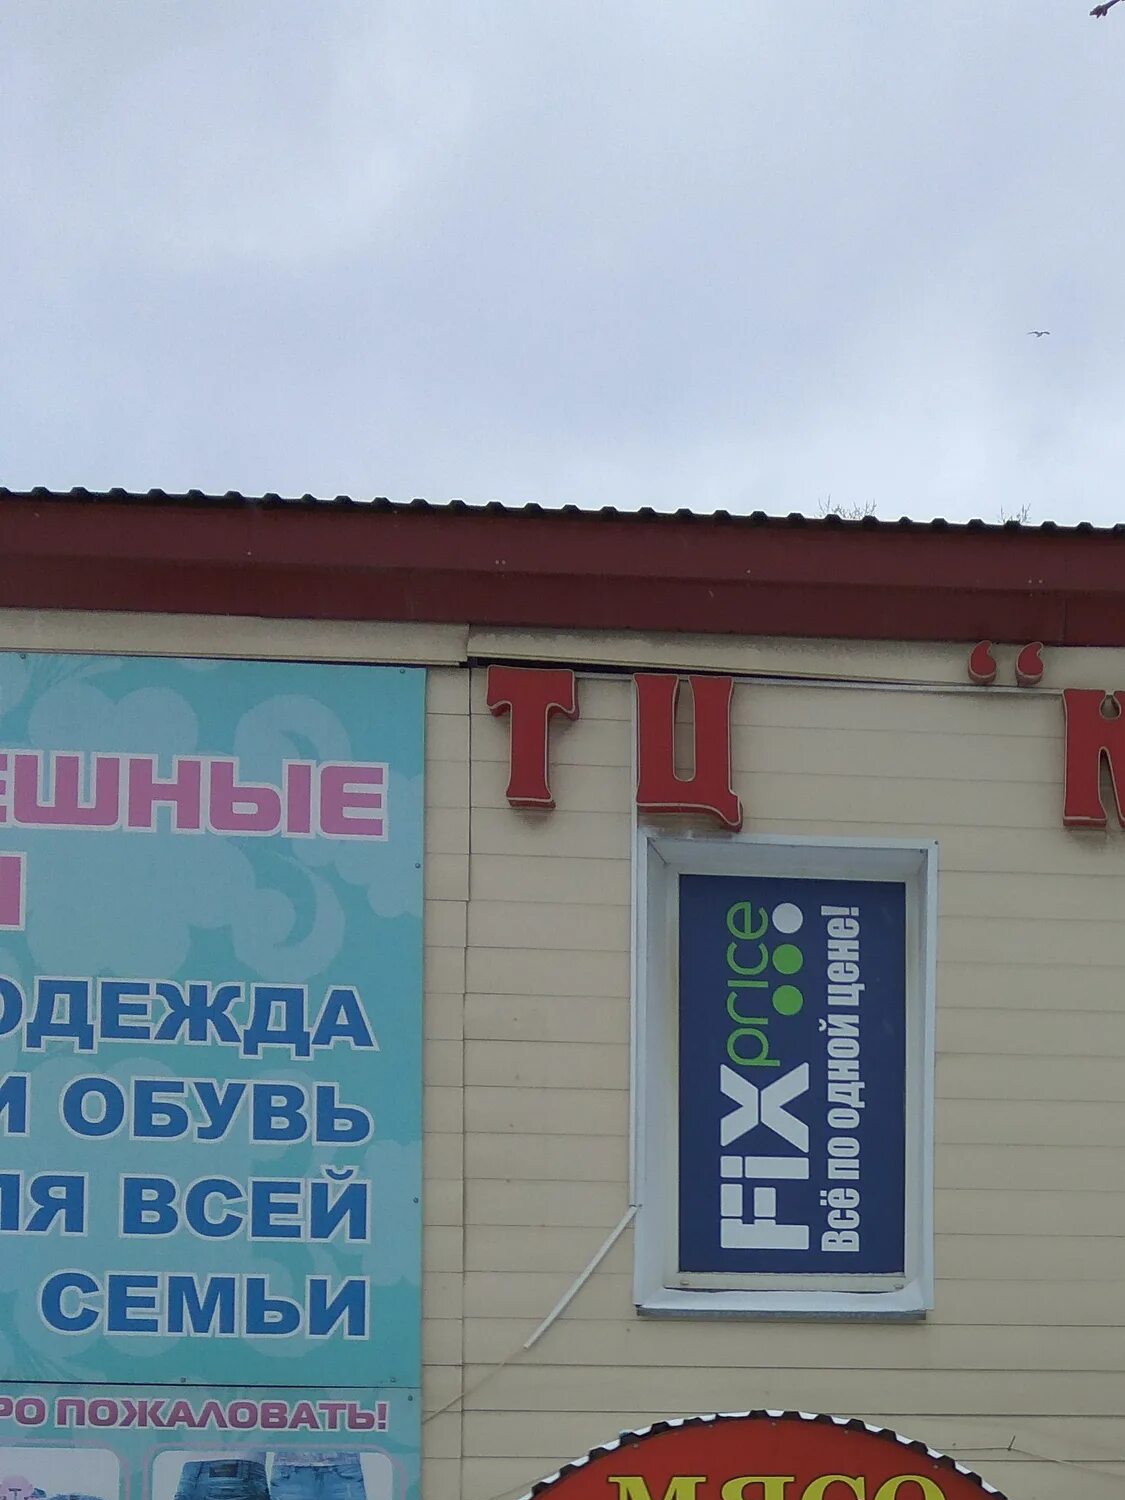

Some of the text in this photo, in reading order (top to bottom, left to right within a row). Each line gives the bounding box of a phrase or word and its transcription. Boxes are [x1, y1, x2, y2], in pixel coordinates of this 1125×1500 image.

[485, 665, 743, 832] ТЦ
[0, 750, 388, 840] ШНЫЕ
[726, 900, 781, 1067] price
[60, 1074, 373, 1146] ОБУВЬ
[818, 904, 866, 1252] Всё по одной цене!
[120, 1165, 371, 1243] ВСЕЙ
[39, 1270, 371, 1341] СЕМЬИ
[55, 1397, 388, 1431] ПОЖАЛОВАТЬ!
